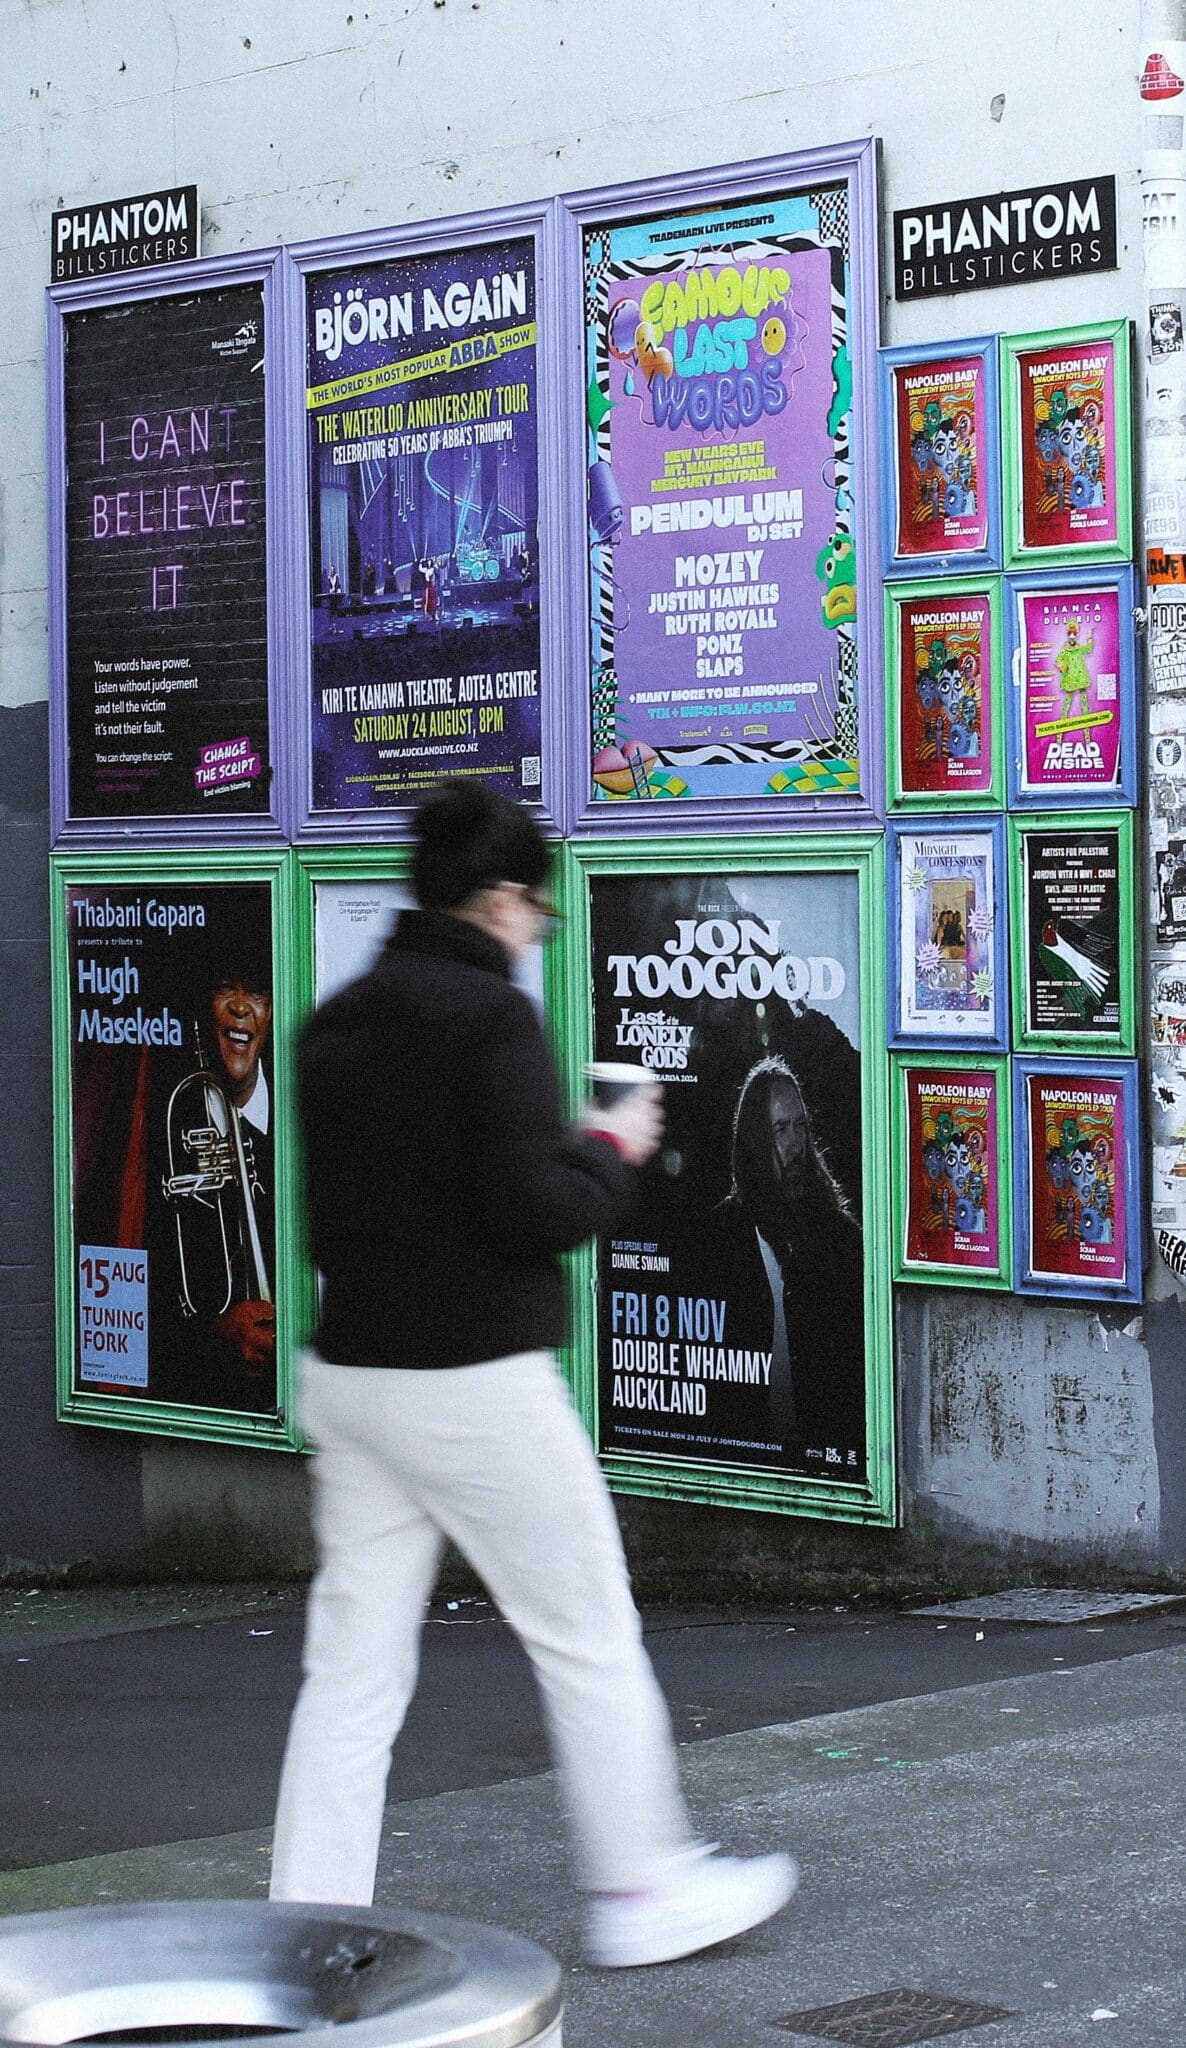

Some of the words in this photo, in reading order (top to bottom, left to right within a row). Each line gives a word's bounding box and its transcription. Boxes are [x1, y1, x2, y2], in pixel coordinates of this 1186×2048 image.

[57, 194, 187, 253] PHANTOM
[649, 226, 704, 243] TRADEMARK
[705, 223, 726, 235] LIVE
[727, 214, 775, 232] PRESENTS
[902, 186, 1101, 261] PHANTOM
[57, 237, 188, 277] BILLSTICKERS
[903, 239, 1101, 291] BILLSTICKERS
[674, 317, 757, 377] LAST
[313, 389, 329, 402] THE
[331, 377, 374, 397] WORLD'S
[375, 370, 400, 384] MOST
[403, 355, 447, 377] POPULAR
[449, 335, 498, 367] ABBA
[500, 330, 530, 348] SHOW
[1028, 360, 1080, 378] NAPOLEON
[1082, 356, 1108, 371] BABY
[904, 374, 953, 390] NAPOLEON
[955, 368, 979, 382] BABY
[652, 357, 788, 431] WORDS
[317, 413, 339, 443] THE
[341, 404, 404, 440] WATERLOO
[407, 389, 493, 430] ANNIVERSARY
[495, 383, 529, 415] TOUR
[99, 421, 104, 465] I
[333, 440, 386, 466] CELEBRATING
[388, 438, 400, 457] 50
[401, 434, 428, 456] YEARS
[430, 433, 442, 451] OF
[442, 427, 473, 449] ABBA'S
[474, 419, 513, 445] TRIUMPH
[665, 449, 692, 464] NEW
[693, 444, 738, 460] YEARS
[739, 440, 765, 457] EVE
[665, 463, 686, 478] MT.
[686, 454, 765, 475] MAUNGANUI
[651, 473, 712, 492] MERCURY
[94, 479, 245, 539] BELIEVE
[630, 488, 804, 536] PENDULUM
[747, 526, 768, 543] DJ
[769, 521, 803, 541] SET
[675, 549, 764, 588] MOZEY
[152, 564, 183, 610] IT
[648, 589, 708, 614] JUSTIN
[709, 583, 780, 609] HAWKES
[910, 612, 959, 626] NAPOLEON
[961, 610, 985, 623] BABY
[1043, 603, 1101, 614] BIANCA
[1043, 616, 1068, 625] DEL
[1077, 614, 1101, 624] RIO
[664, 612, 713, 636] RUTH
[714, 607, 777, 632] ROYALL
[696, 633, 743, 657] PONZ
[94, 660, 111, 673] Your
[114, 657, 139, 672] words
[140, 658, 160, 672] have
[162, 657, 191, 673] power.
[696, 656, 744, 678] SLAPS
[94, 680, 118, 694] Listen
[119, 679, 150, 693] without
[151, 677, 198, 693] judgement
[322, 686, 344, 715] KIRI
[344, 686, 358, 713] TE
[359, 681, 404, 711] KANAWA
[406, 677, 456, 708] THEATRE,
[458, 673, 493, 702] AOTEA
[496, 669, 538, 699] CENTRE
[636, 691, 671, 704] MANY
[672, 688, 705, 702] MORE
[706, 688, 724, 700] TO
[724, 686, 741, 698] BE
[742, 682, 818, 698] ANNOUNCED
[94, 702, 110, 714] and
[111, 701, 124, 714] tell
[126, 700, 139, 713] the
[140, 699, 166, 712] victim
[94, 723, 107, 736] it's
[108, 723, 122, 735] not
[123, 721, 142, 734] their
[144, 720, 165, 734] fault.
[354, 713, 410, 743] SATURDAY
[412, 713, 427, 739] 24
[429, 708, 477, 738] AUGUST,
[479, 705, 504, 733] 8PM
[95, 753, 107, 762] You
[108, 754, 118, 762] can
[120, 752, 141, 764] change
[142, 752, 152, 761] the
[204, 741, 247, 763] CHANGE
[378, 742, 479, 760] WWW.AUCKLANDLIVE.CO.NZ
[1046, 741, 1100, 758] DEAD
[196, 767, 216, 783] THE
[219, 757, 255, 778] SCRIPT
[1043, 758, 1105, 770] INSIDE
[928, 856, 983, 868] CONFESSIONS
[1042, 847, 1065, 857] ARTISTS
[1066, 847, 1077, 857] FOR
[1078, 846, 1109, 857] PALESTINE
[73, 898, 141, 927] Thabani
[145, 899, 206, 936] Gapara
[111, 937, 133, 945] tribute
[664, 919, 781, 956] JON
[78, 956, 139, 1005] Hugh
[607, 955, 846, 1000] TOOGOOD
[78, 1007, 182, 1046] Masekela
[620, 1008, 667, 1025] Last
[616, 1024, 694, 1047] LONELY
[641, 1046, 688, 1069] GODS
[681, 1075, 698, 1083] 2024
[918, 1084, 966, 1098] NAPOLEON
[968, 1086, 992, 1099] BABY
[921, 1096, 951, 1104] UNWORTHY
[1040, 1090, 1091, 1104] NAPOLEON
[1093, 1092, 1118, 1106] BABY
[1045, 1102, 1075, 1110] UNWORTHY
[1100, 1104, 1114, 1112] TOUR
[970, 1244, 990, 1253] LAGOON
[1095, 1254, 1115, 1263] LAGOON
[612, 1253, 640, 1270] DIANNE
[641, 1256, 670, 1272] SWANN
[80, 1258, 109, 1298] 15
[111, 1262, 145, 1284] AUG
[82, 1306, 144, 1331] TUNING
[612, 1290, 647, 1335] FRI
[655, 1295, 670, 1338] 8
[678, 1296, 726, 1343] NOV
[83, 1330, 129, 1354] FORK
[612, 1338, 680, 1377] DOUBLE
[685, 1344, 773, 1386] WHAMMY
[612, 1374, 707, 1416] AUCKLAND
[614, 1425, 641, 1436] TICKETS
[652, 1430, 669, 1439] SALE
[670, 1432, 685, 1441] MON
[696, 1435, 711, 1444] JULY
[719, 1437, 782, 1452] JONTOOGOOD.COM
[826, 1447, 837, 1456] THE
